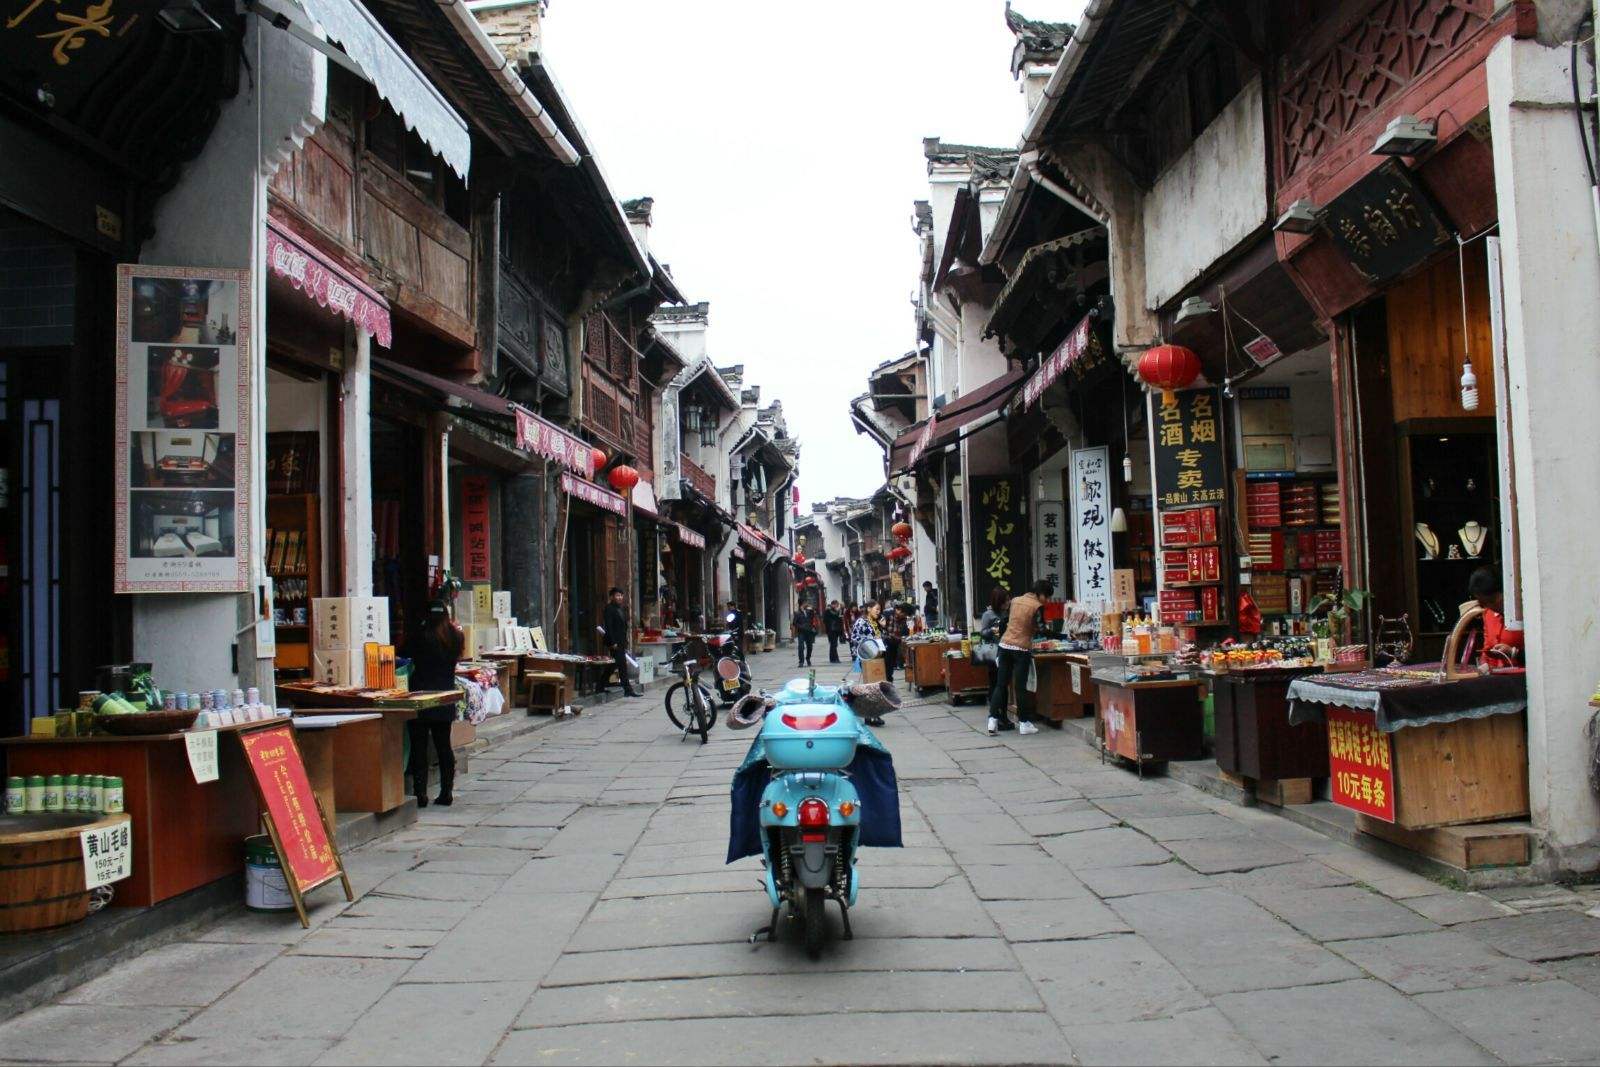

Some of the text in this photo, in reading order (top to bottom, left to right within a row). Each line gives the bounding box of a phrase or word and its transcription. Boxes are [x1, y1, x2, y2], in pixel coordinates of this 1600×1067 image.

[1158, 399, 1184, 447] 名酒
[1190, 395, 1216, 443] 名烟
[1175, 448, 1203, 489] 专卖
[1158, 492, 1188, 504] 一品黄山
[1192, 488, 1225, 502] 天高云淡
[1044, 513, 1060, 589] 茗茶专卖
[1337, 771, 1385, 808] 10元每条
[95, 852, 125, 870] 150元一斤
